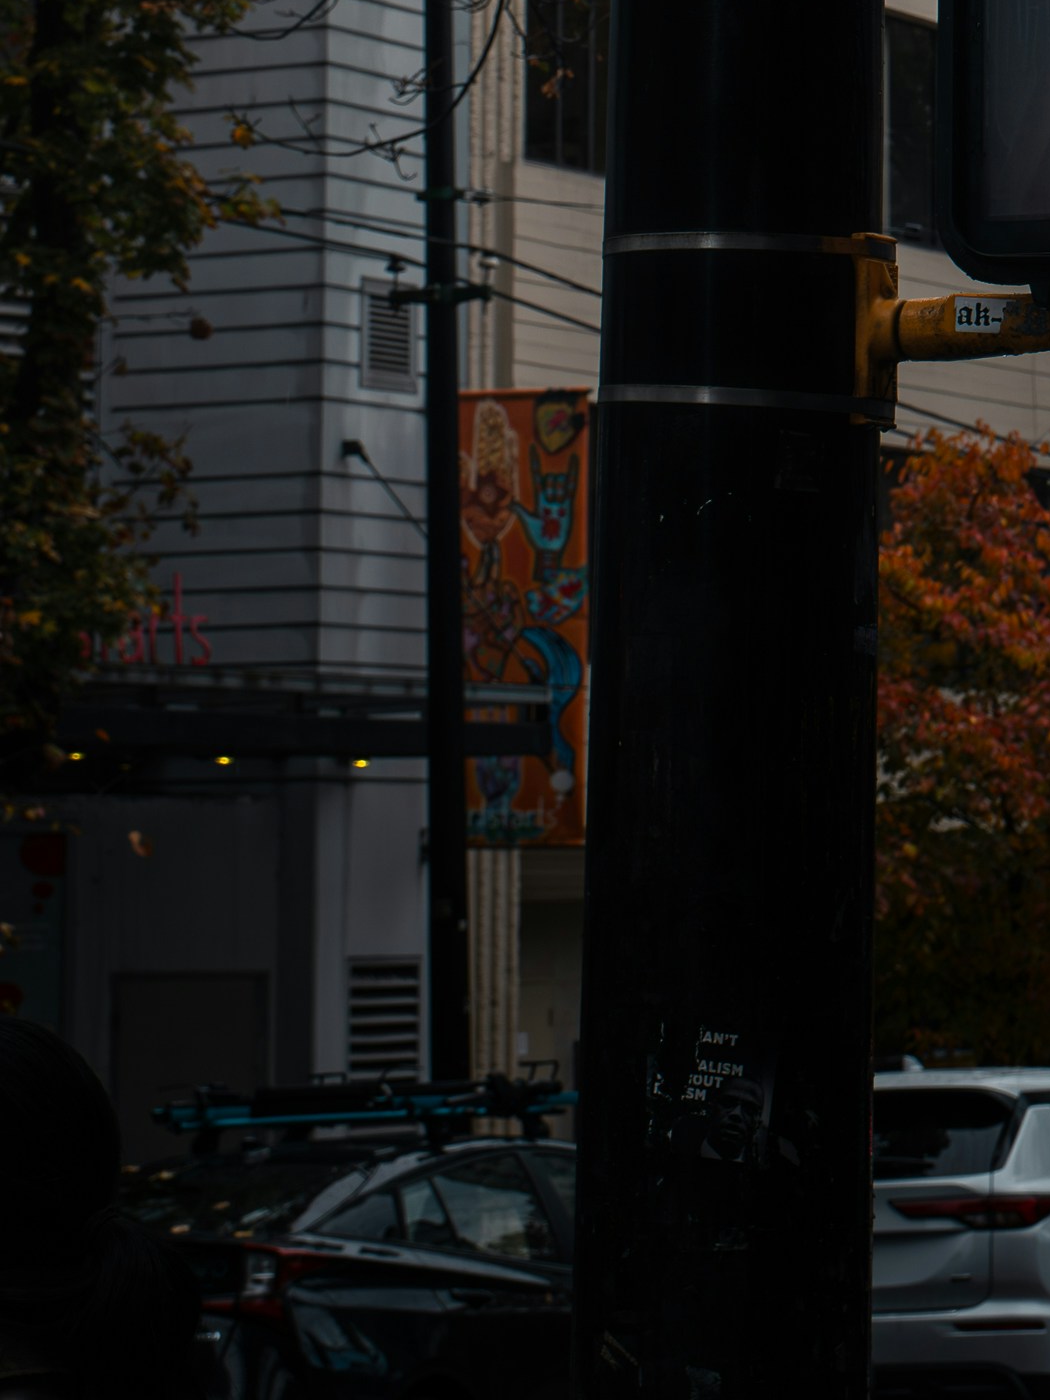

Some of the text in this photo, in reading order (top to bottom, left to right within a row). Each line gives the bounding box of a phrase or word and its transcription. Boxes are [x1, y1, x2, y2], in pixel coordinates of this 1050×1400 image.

[699, 1028, 740, 1047] AN'T
[696, 1058, 745, 1077] ALISM
[688, 1072, 724, 1089] OUT
